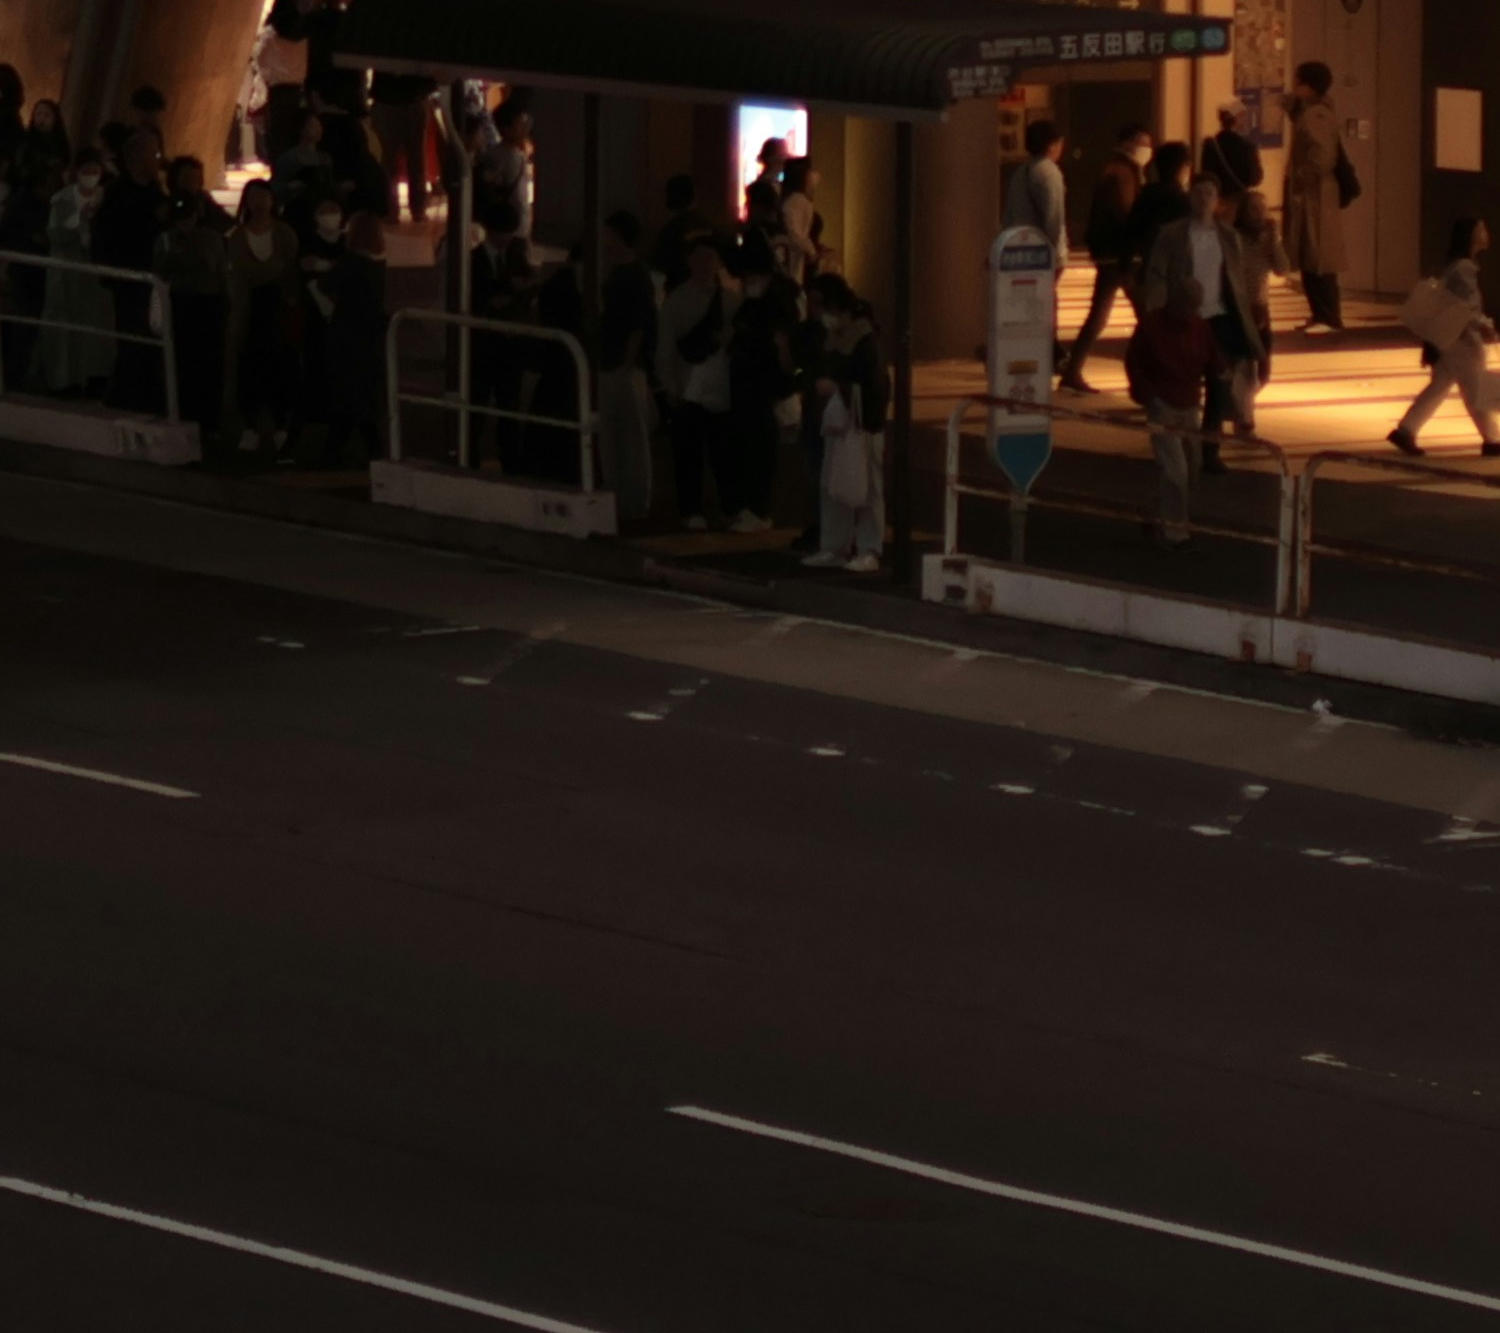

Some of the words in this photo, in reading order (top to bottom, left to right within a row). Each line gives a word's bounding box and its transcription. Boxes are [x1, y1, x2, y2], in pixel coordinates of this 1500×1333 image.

[1058, 29, 1166, 60] 五反田駅行
